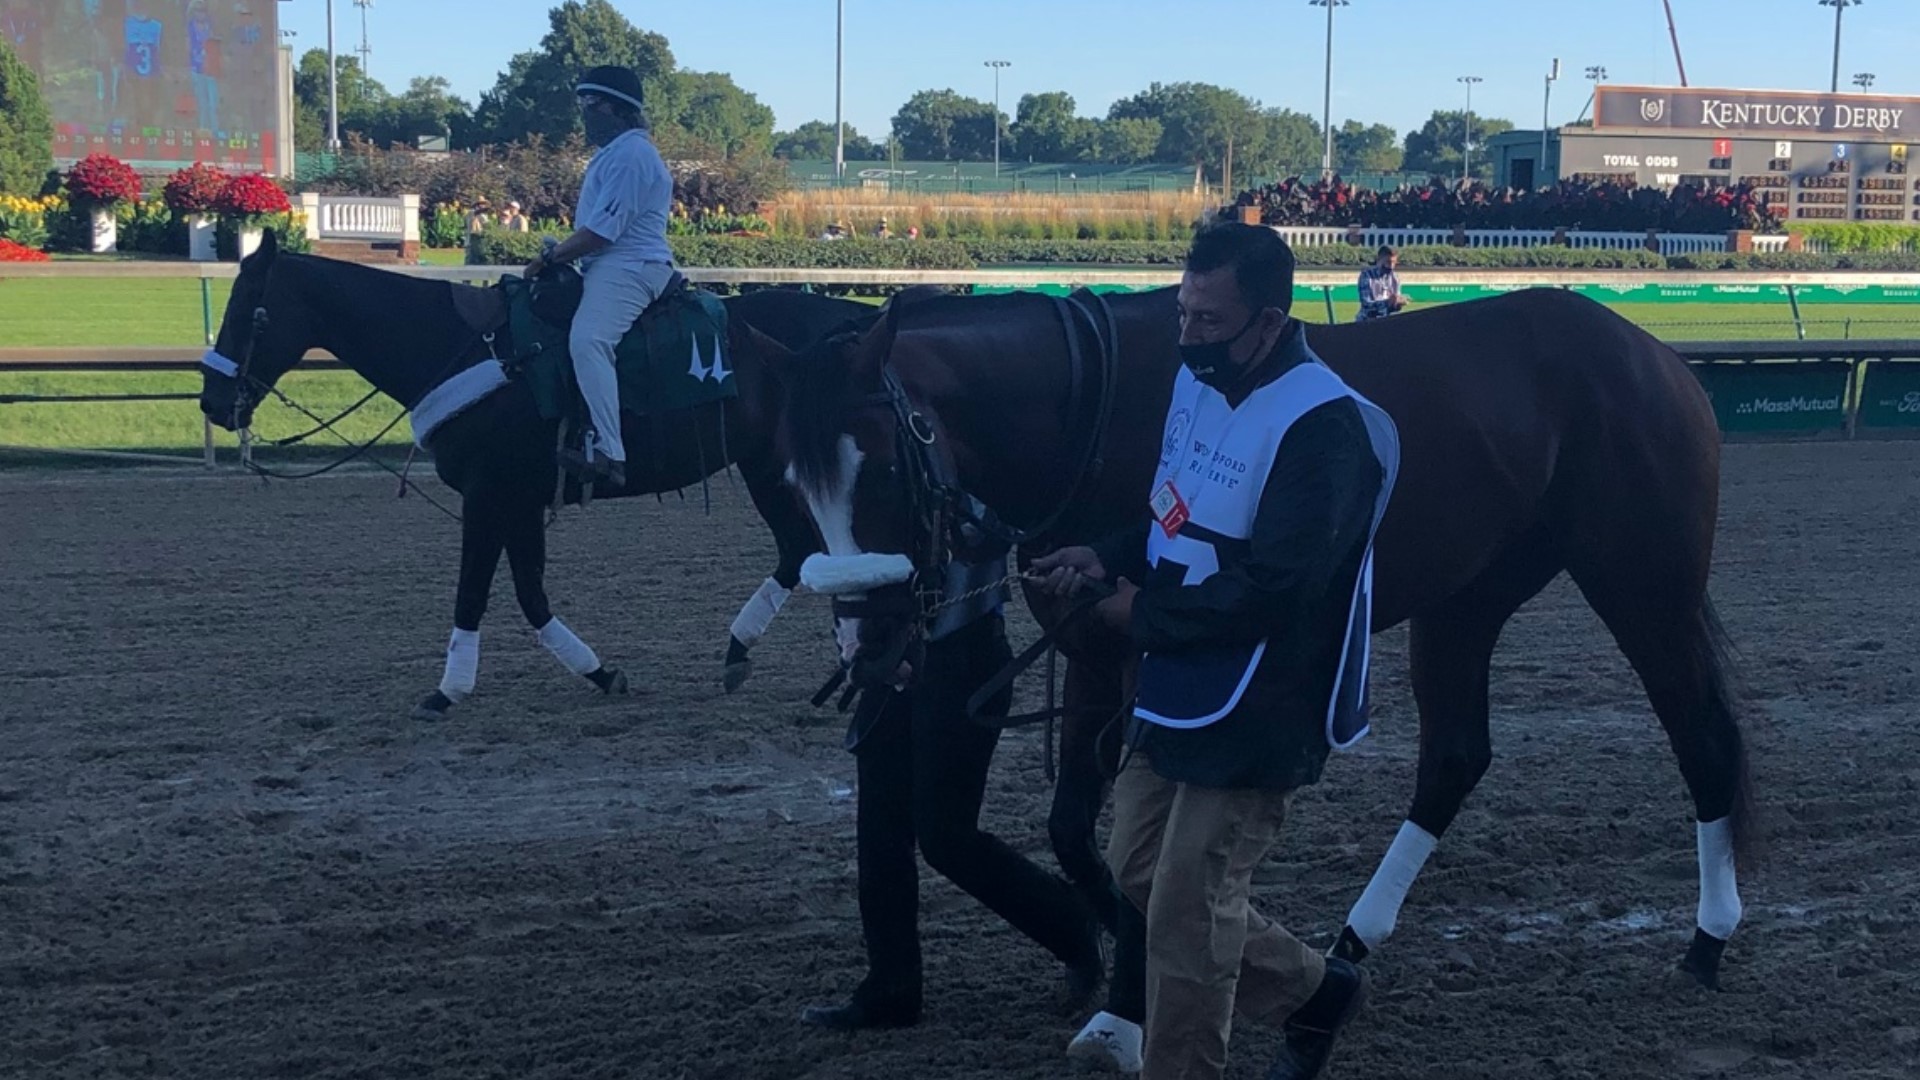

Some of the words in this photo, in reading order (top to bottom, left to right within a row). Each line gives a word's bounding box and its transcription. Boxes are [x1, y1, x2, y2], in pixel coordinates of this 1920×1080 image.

[136, 45, 152, 75] 3
[1701, 100, 1825, 129] KENTUCKY
[1833, 104, 1903, 132] DERBY
[1719, 141, 1726, 155] 1
[1780, 143, 1786, 156] 2
[1837, 143, 1845, 158] 3
[1894, 146, 1902, 157] 4
[1603, 155, 1640, 166] TOTAL
[1645, 155, 1678, 167] ODDS
[1656, 173, 1679, 184] WIN
[1753, 396, 1839, 413] MassMutual
[1194, 440, 1246, 473] WODFORD
